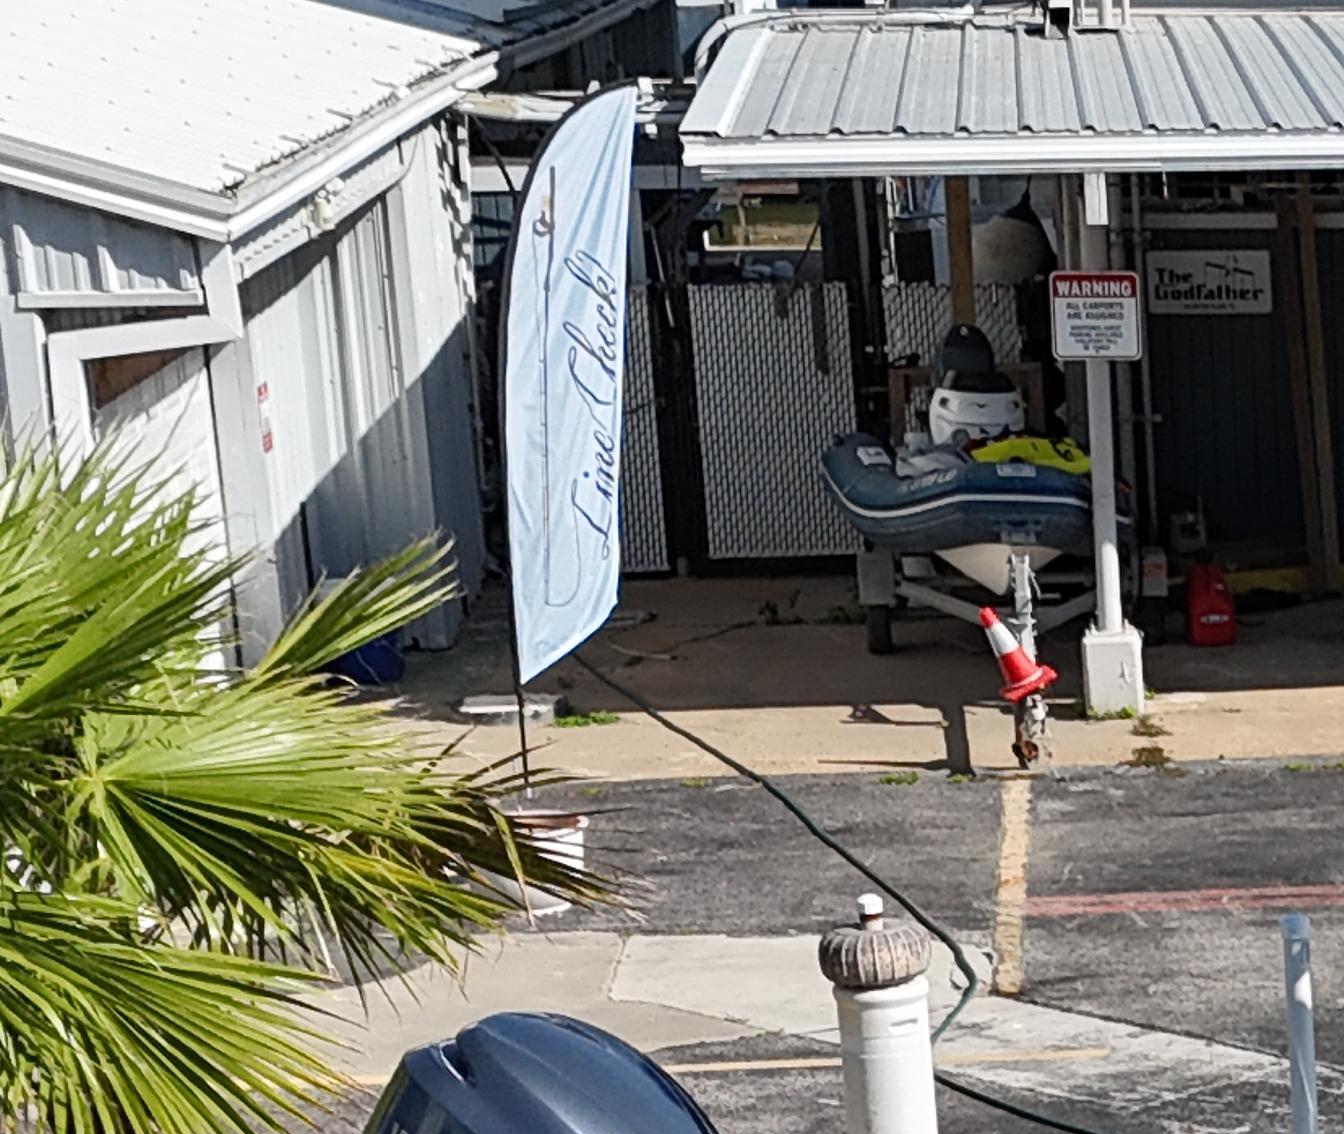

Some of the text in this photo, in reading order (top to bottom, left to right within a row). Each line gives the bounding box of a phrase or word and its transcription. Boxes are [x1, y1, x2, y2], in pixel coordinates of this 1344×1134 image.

[1154, 267, 1193, 283] The
[1056, 279, 1132, 297] WARNING
[1154, 284, 1265, 300] Godfather
[571, 429, 615, 561] Line
